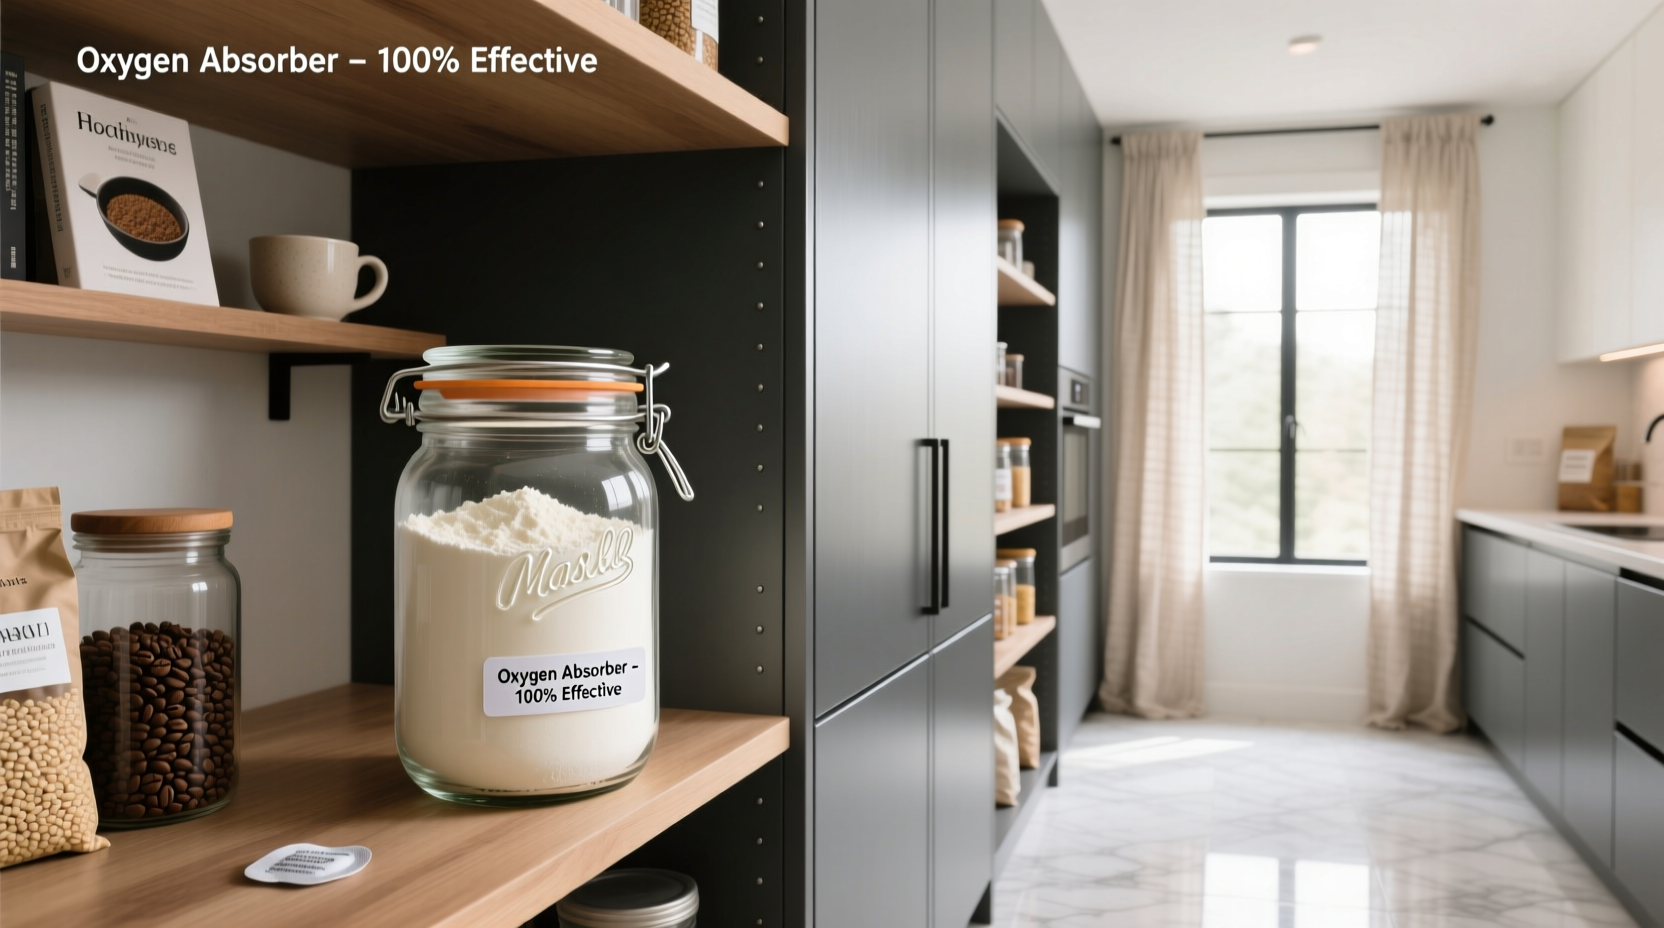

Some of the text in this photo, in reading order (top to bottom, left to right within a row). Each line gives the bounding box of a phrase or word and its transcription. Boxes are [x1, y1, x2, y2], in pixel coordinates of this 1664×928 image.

[497, 668, 557, 688] Oxygen
[561, 660, 628, 680] Absorber
[515, 682, 622, 704] 100% Effective
